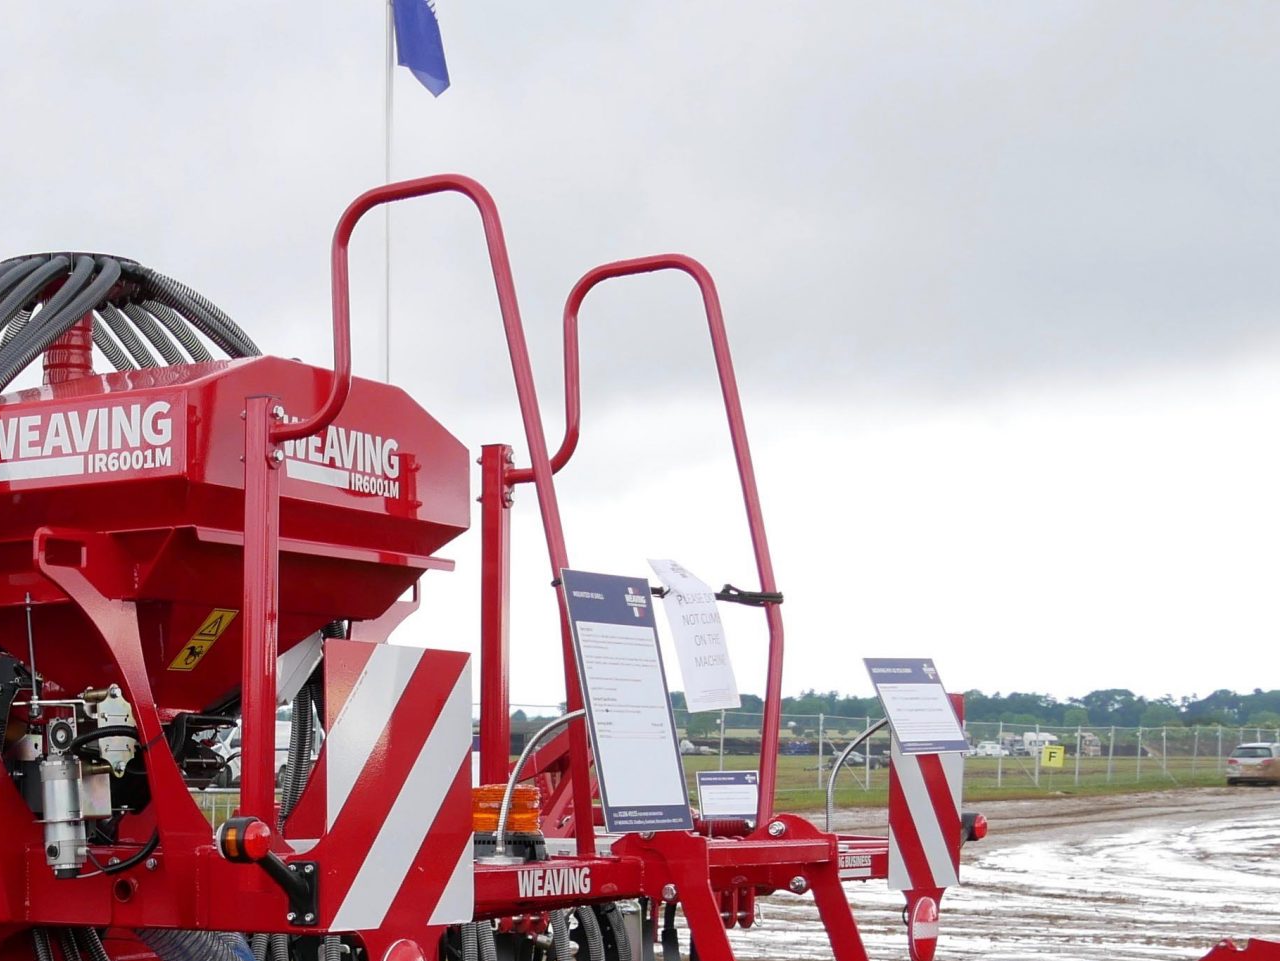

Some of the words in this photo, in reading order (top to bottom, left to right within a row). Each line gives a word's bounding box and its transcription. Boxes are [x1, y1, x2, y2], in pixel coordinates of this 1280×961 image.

[282, 414, 400, 479] WEAVING
[87, 446, 173, 475] IR6001M
[350, 472, 400, 500] IR6001M
[682, 613, 700, 626] NOT
[694, 634, 707, 647] ON
[707, 633, 721, 645] THE
[1048, 751, 1058, 763] F
[844, 854, 872, 869] BUSINESS
[516, 866, 592, 898] WEAVING
